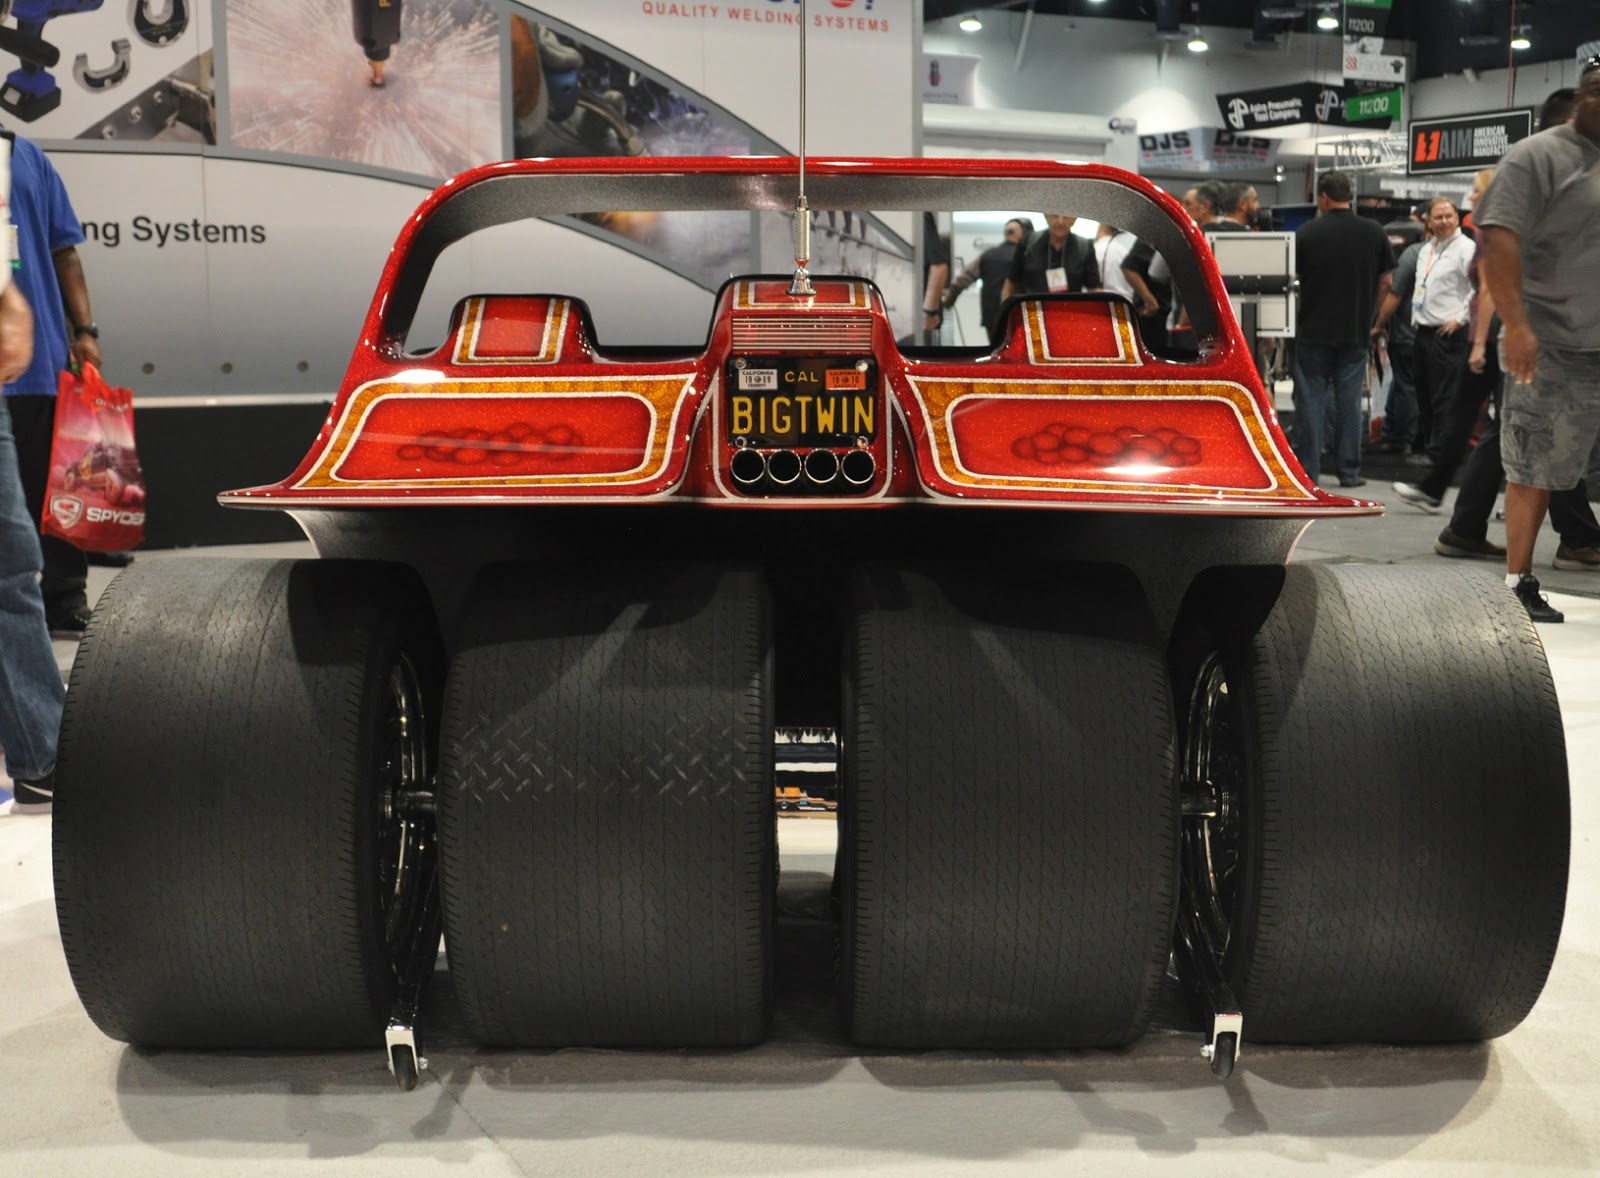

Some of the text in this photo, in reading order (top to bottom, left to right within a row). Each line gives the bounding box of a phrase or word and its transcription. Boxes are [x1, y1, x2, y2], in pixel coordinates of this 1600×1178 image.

[642, 1, 718, 17] QUALITY
[814, 15, 888, 32] SYSTEMS
[1348, 18, 1375, 33] 11200
[1360, 96, 1389, 114] 11200
[1269, 108, 1301, 121] Company
[1474, 125, 1506, 137] AMERICAN
[1139, 131, 1191, 151] DJS
[1438, 128, 1474, 159] AIM
[81, 215, 266, 248] ng Systems
[784, 371, 818, 383] CAL
[732, 396, 874, 434] BIGTWIN
[86, 507, 145, 525] SPYDE
